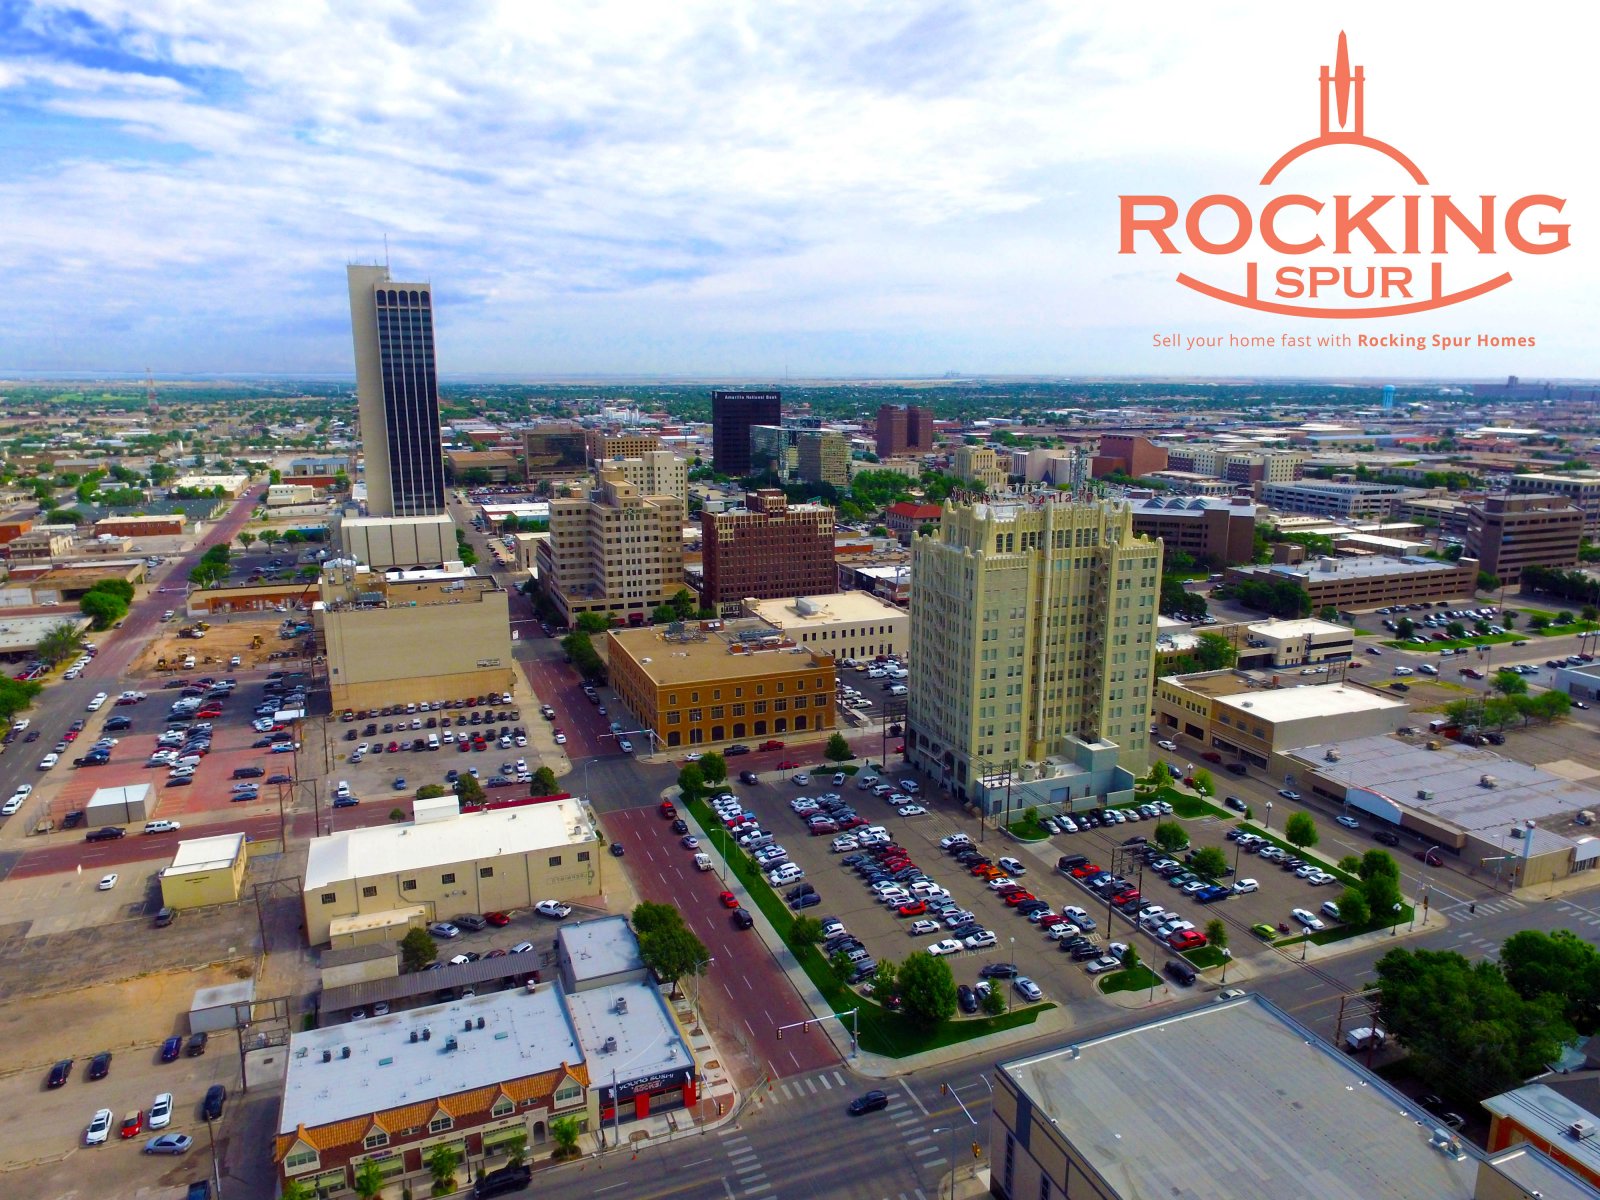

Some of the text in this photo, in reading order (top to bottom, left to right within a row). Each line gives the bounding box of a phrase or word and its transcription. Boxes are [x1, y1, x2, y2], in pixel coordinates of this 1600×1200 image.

[1028, 491, 1072, 505] Santa
[619, 1078, 648, 1090] YOUNG
[650, 1073, 674, 1081] SUSHI
